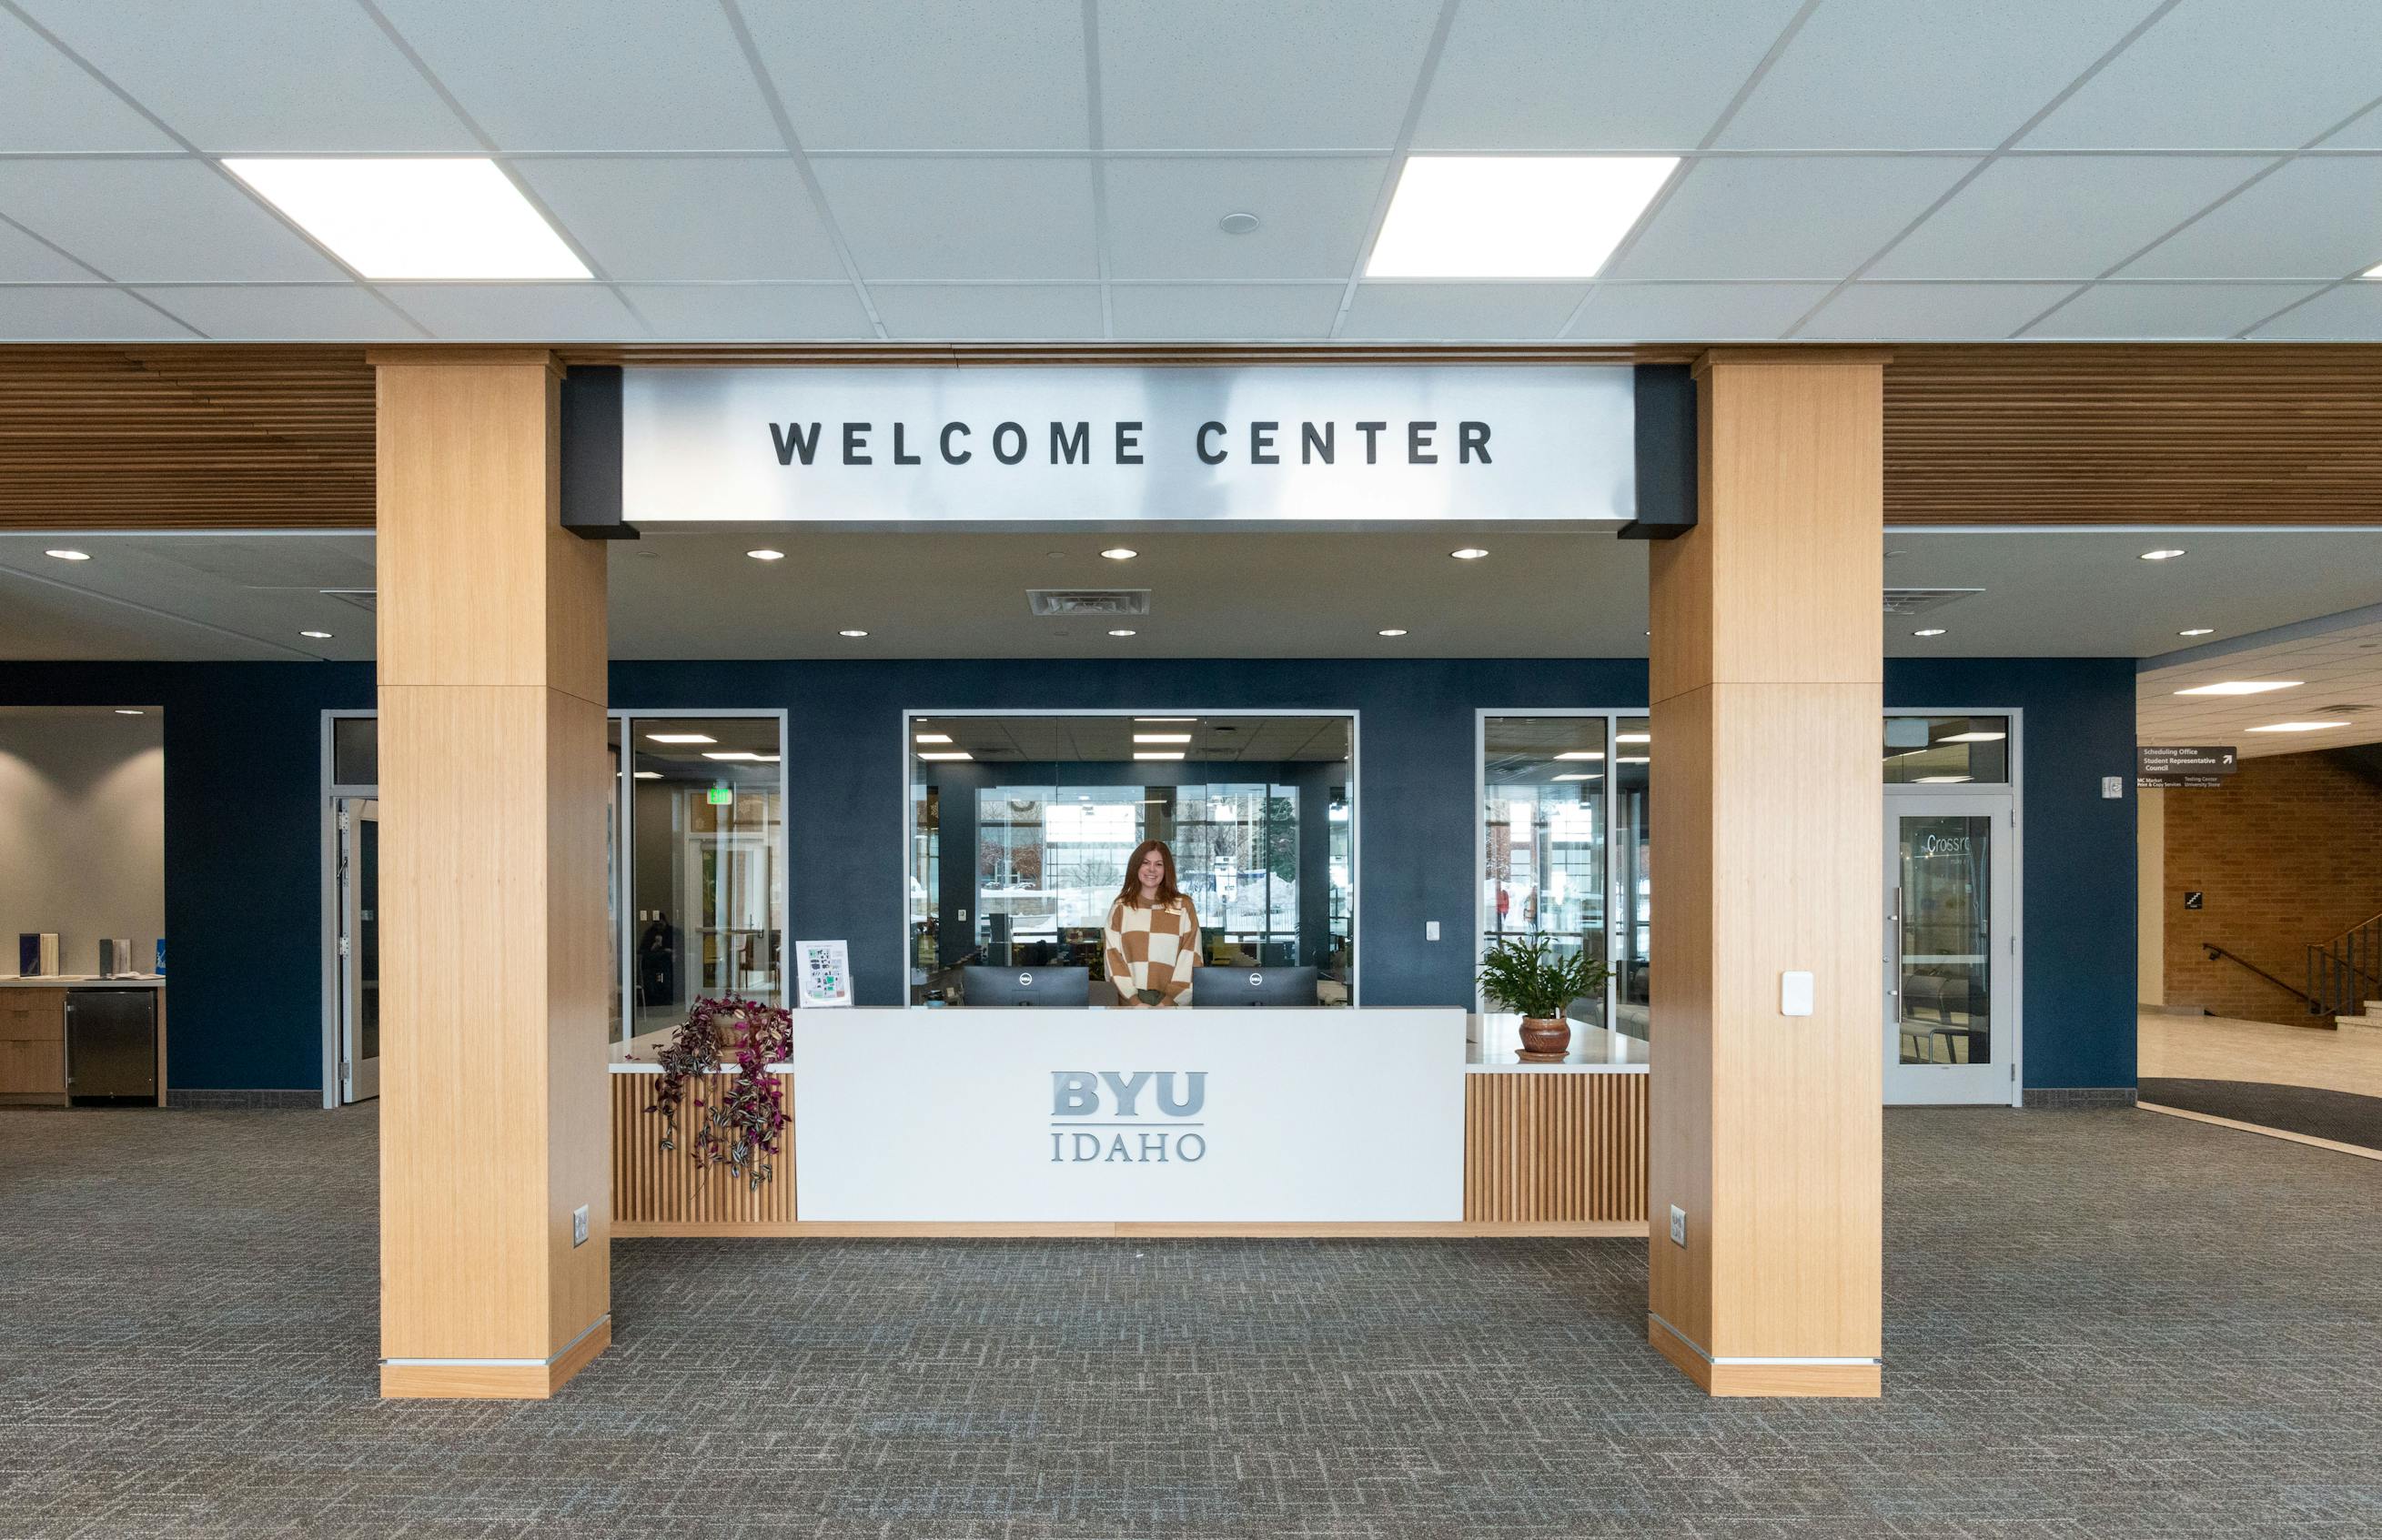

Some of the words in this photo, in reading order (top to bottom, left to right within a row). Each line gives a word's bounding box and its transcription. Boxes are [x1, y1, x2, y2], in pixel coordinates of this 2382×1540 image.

[769, 421, 1144, 466] WELCOME
[1196, 420, 1492, 465] CENTER
[1050, 1071, 1209, 1117] BYU
[1050, 1132, 1206, 1163] IDAHO
